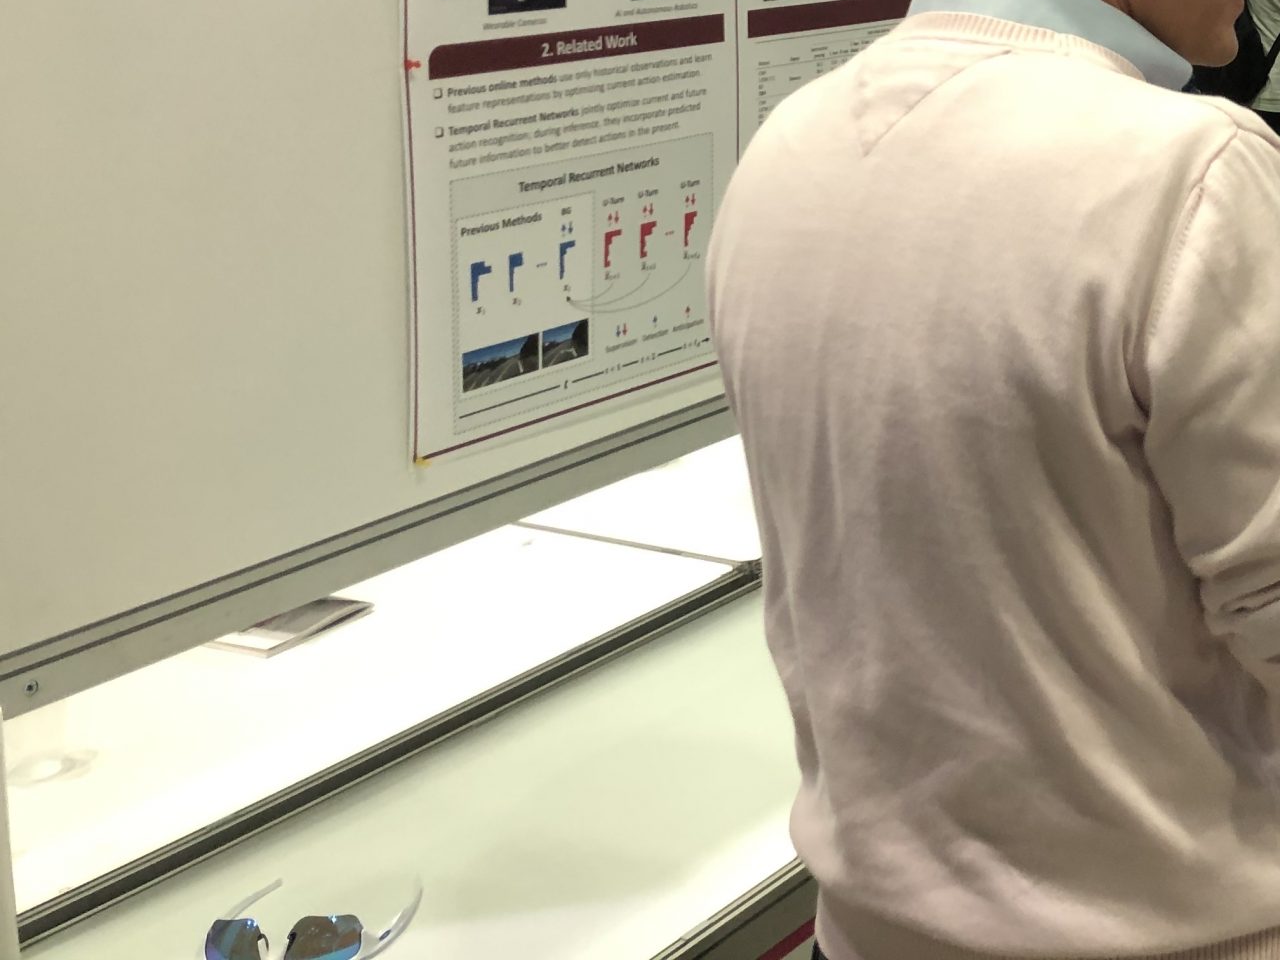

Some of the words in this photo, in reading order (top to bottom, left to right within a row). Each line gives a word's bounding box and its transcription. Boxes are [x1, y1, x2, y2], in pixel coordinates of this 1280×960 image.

[541, 42, 553, 58] 2.
[556, 36, 602, 55] Related
[604, 32, 638, 50] Work
[447, 84, 486, 97] Previous
[488, 80, 517, 91] online
[519, 74, 557, 87] methods
[553, 90, 563, 100] by
[606, 79, 636, 90] current
[448, 120, 491, 136] Temporal
[493, 114, 537, 129] Recurrent
[539, 107, 579, 121] Networks
[641, 94, 669, 106] current
[670, 89, 684, 100] and
[667, 102, 702, 116] predicted
[449, 157, 477, 169] future
[479, 147, 532, 164] information
[533, 145, 543, 155] to
[518, 173, 567, 193] Temporal
[568, 165, 615, 185] Recurrent
[617, 156, 660, 174] Networks
[460, 221, 500, 238] Previous
[502, 211, 543, 230] Methods
